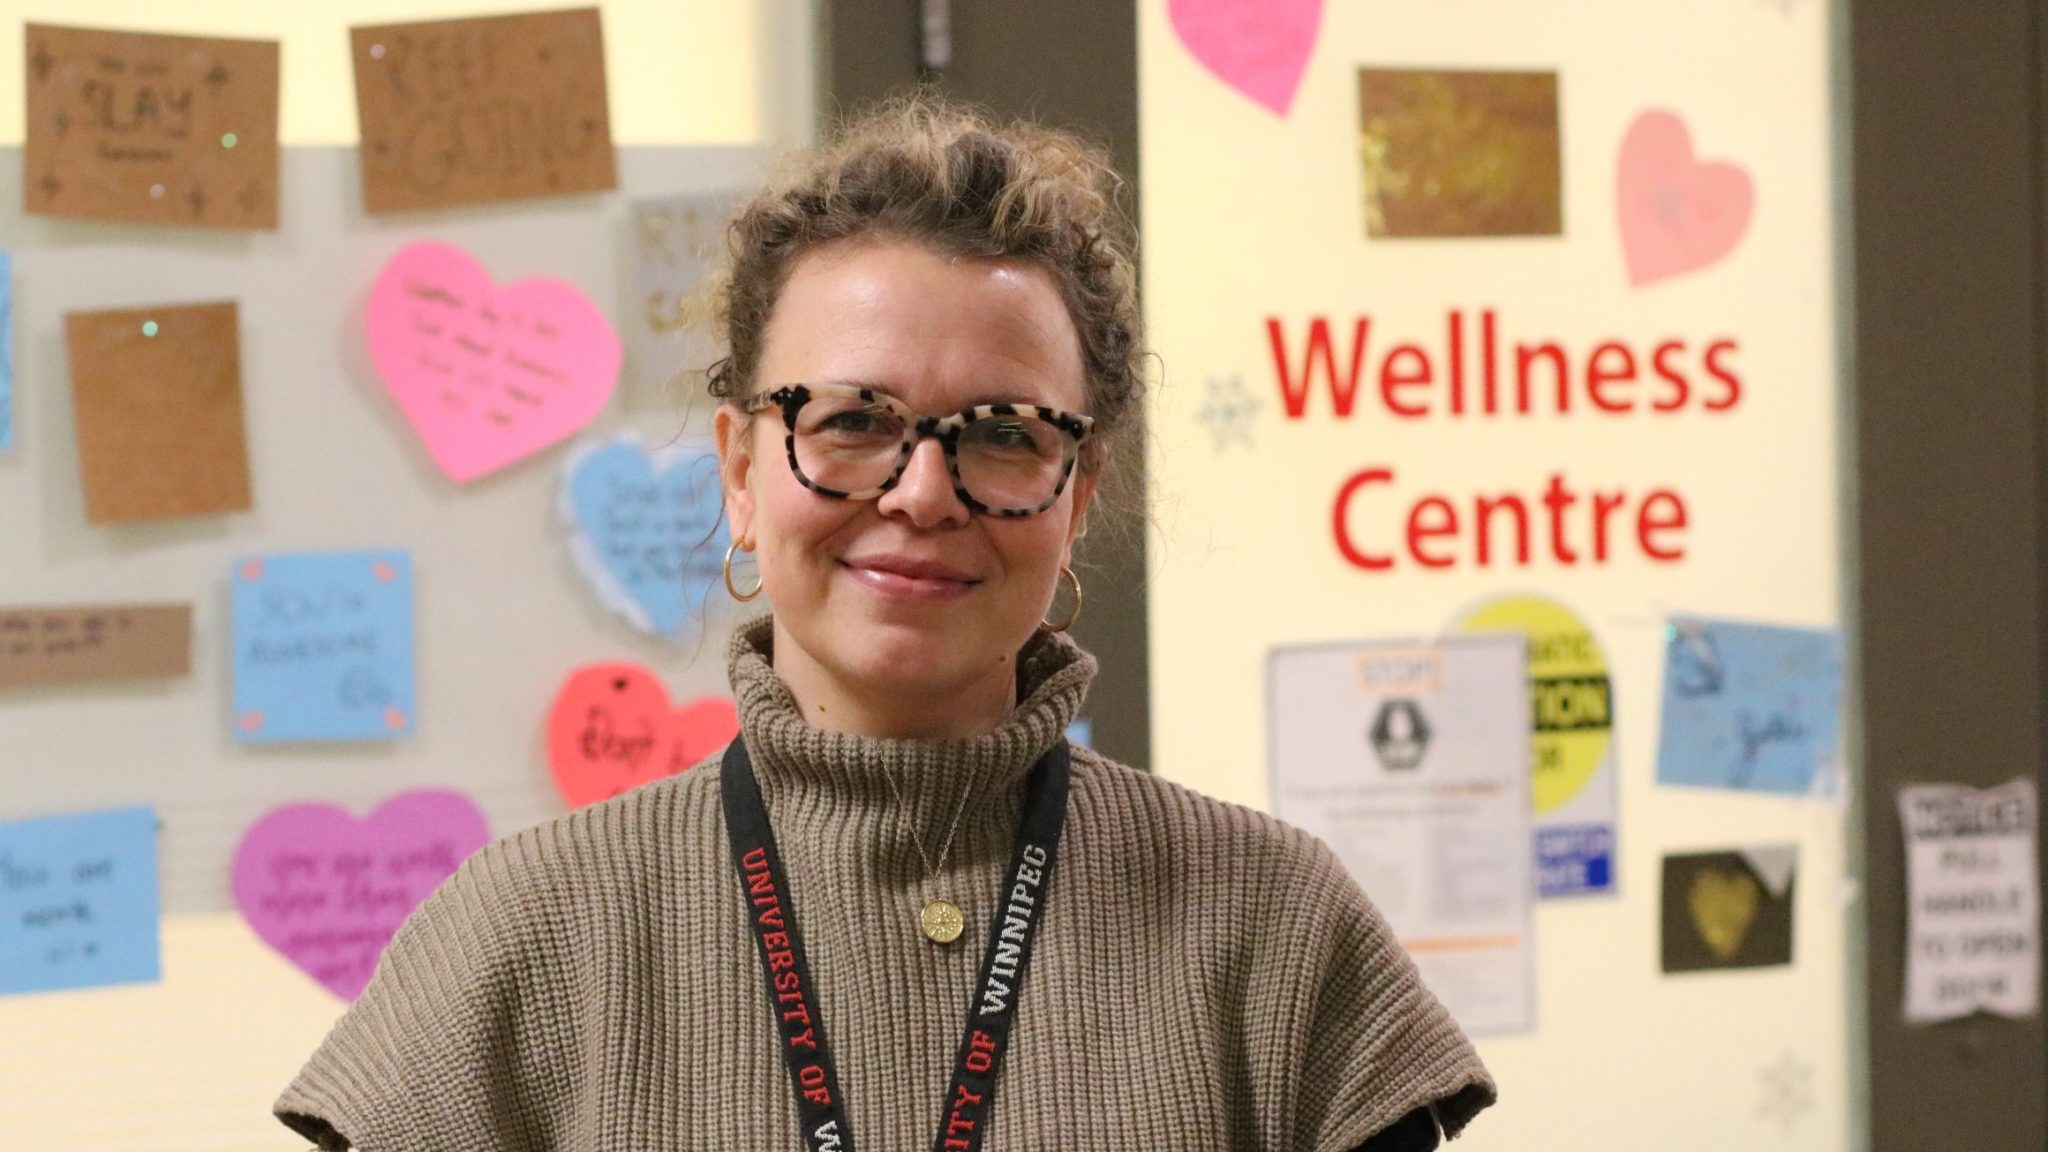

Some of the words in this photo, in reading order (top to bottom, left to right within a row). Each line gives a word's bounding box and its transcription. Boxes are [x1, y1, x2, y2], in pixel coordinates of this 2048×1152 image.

[80, 79, 193, 138] SLAY
[1266, 309, 1743, 421] Wellness
[1331, 467, 1689, 572] Centre
[742, 847, 816, 1049] UNIVERSITY
[799, 1065, 831, 1105] OF
[979, 844, 1048, 1016] WINNIPEG
[965, 1030, 997, 1072] OF
